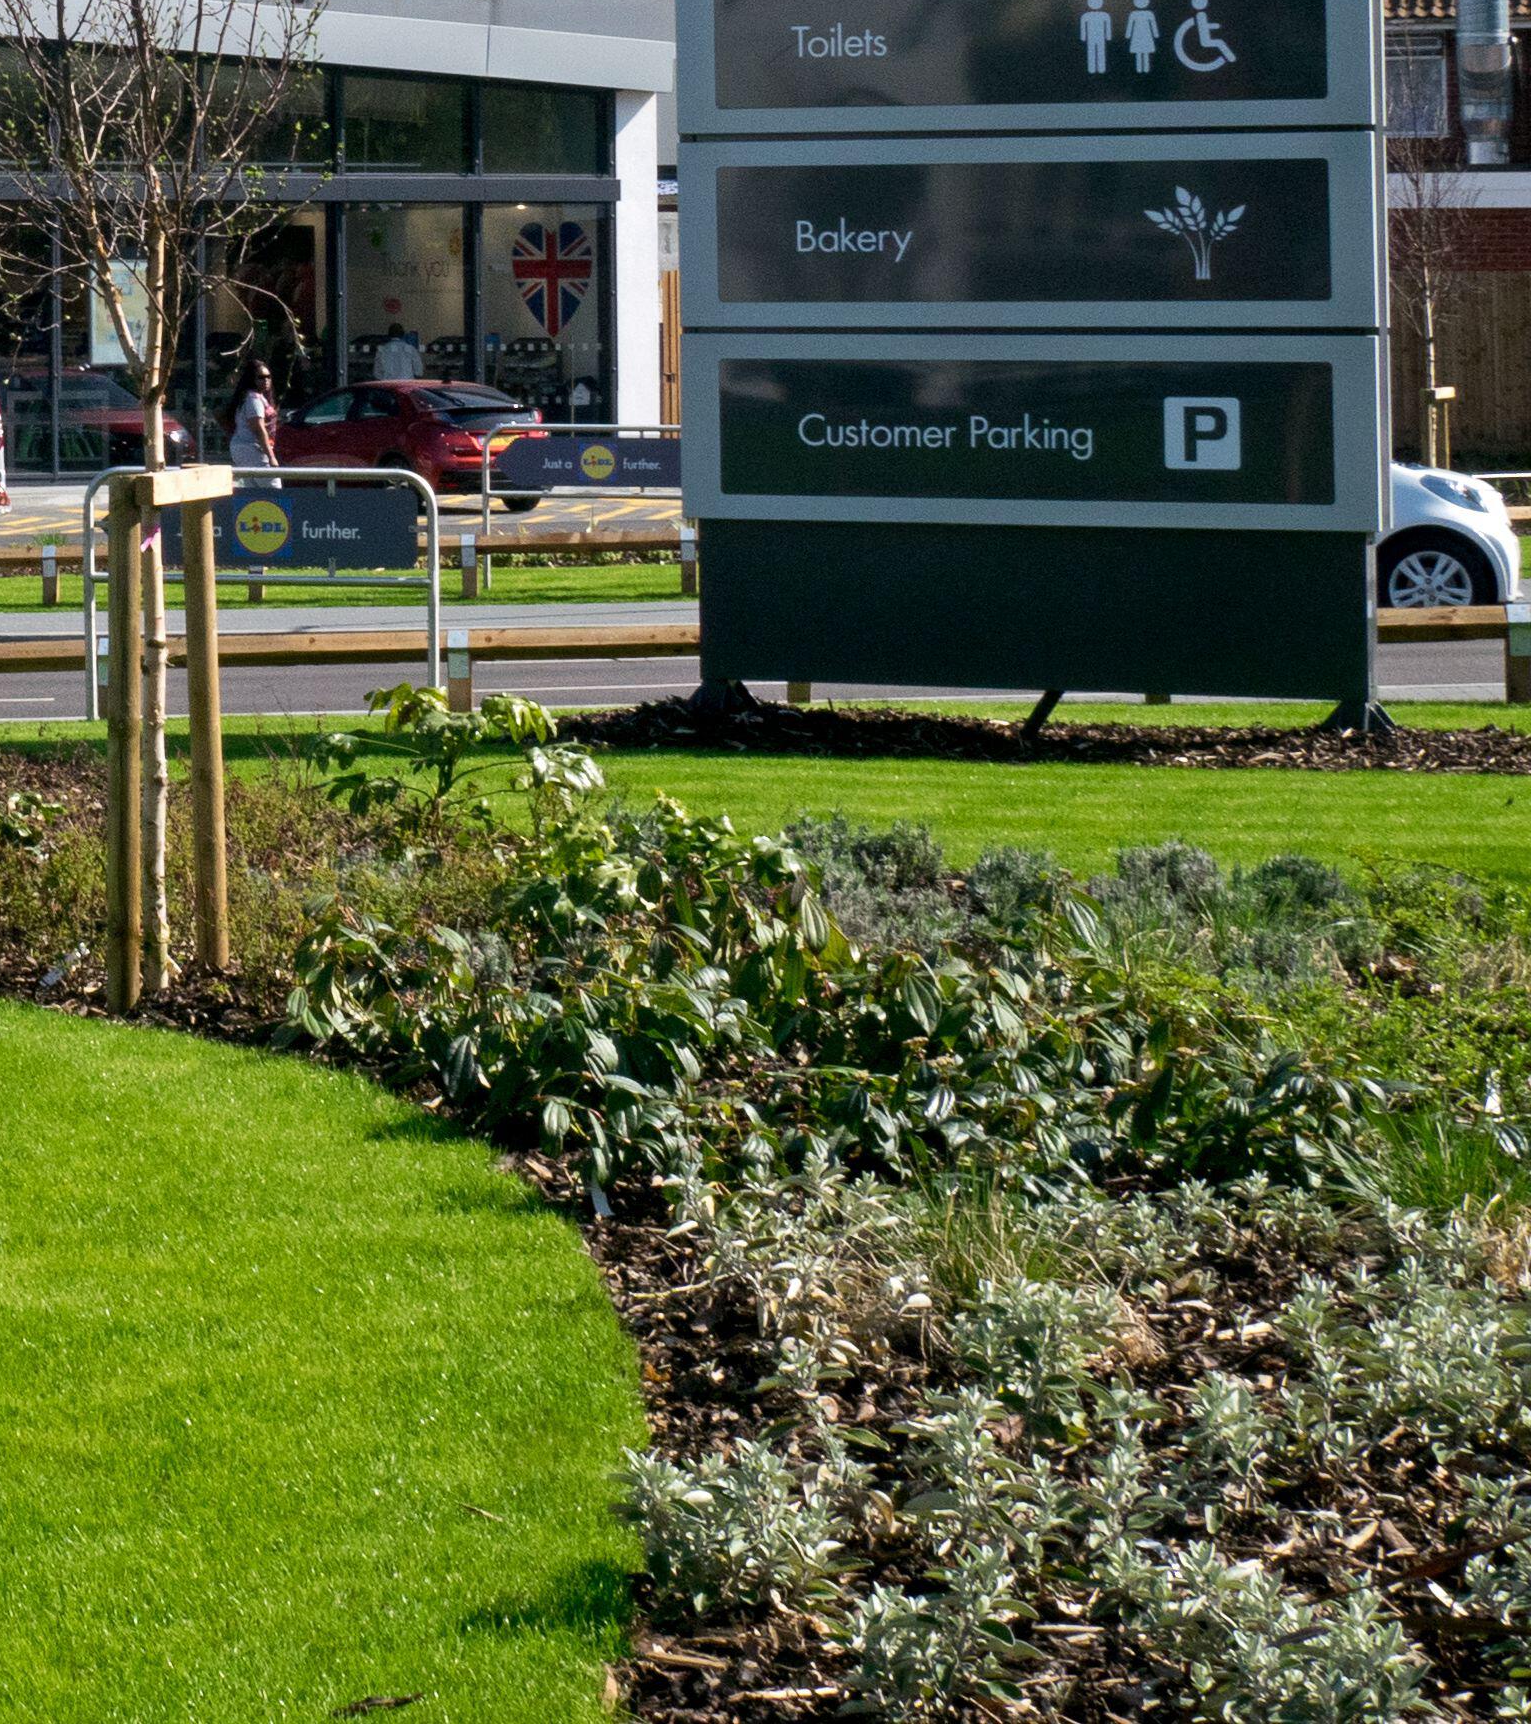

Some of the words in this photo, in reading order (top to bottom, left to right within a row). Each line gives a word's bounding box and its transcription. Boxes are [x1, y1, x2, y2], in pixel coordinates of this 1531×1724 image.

[790, 22, 888, 59] Toilets
[796, 217, 913, 262] Bakery
[799, 412, 956, 449] Customer
[971, 414, 1094, 460] Parking
[1184, 406, 1228, 463] P
[542, 458, 563, 469] Just
[564, 461, 573, 469] a
[623, 457, 661, 470] further.
[302, 520, 361, 540] further.
